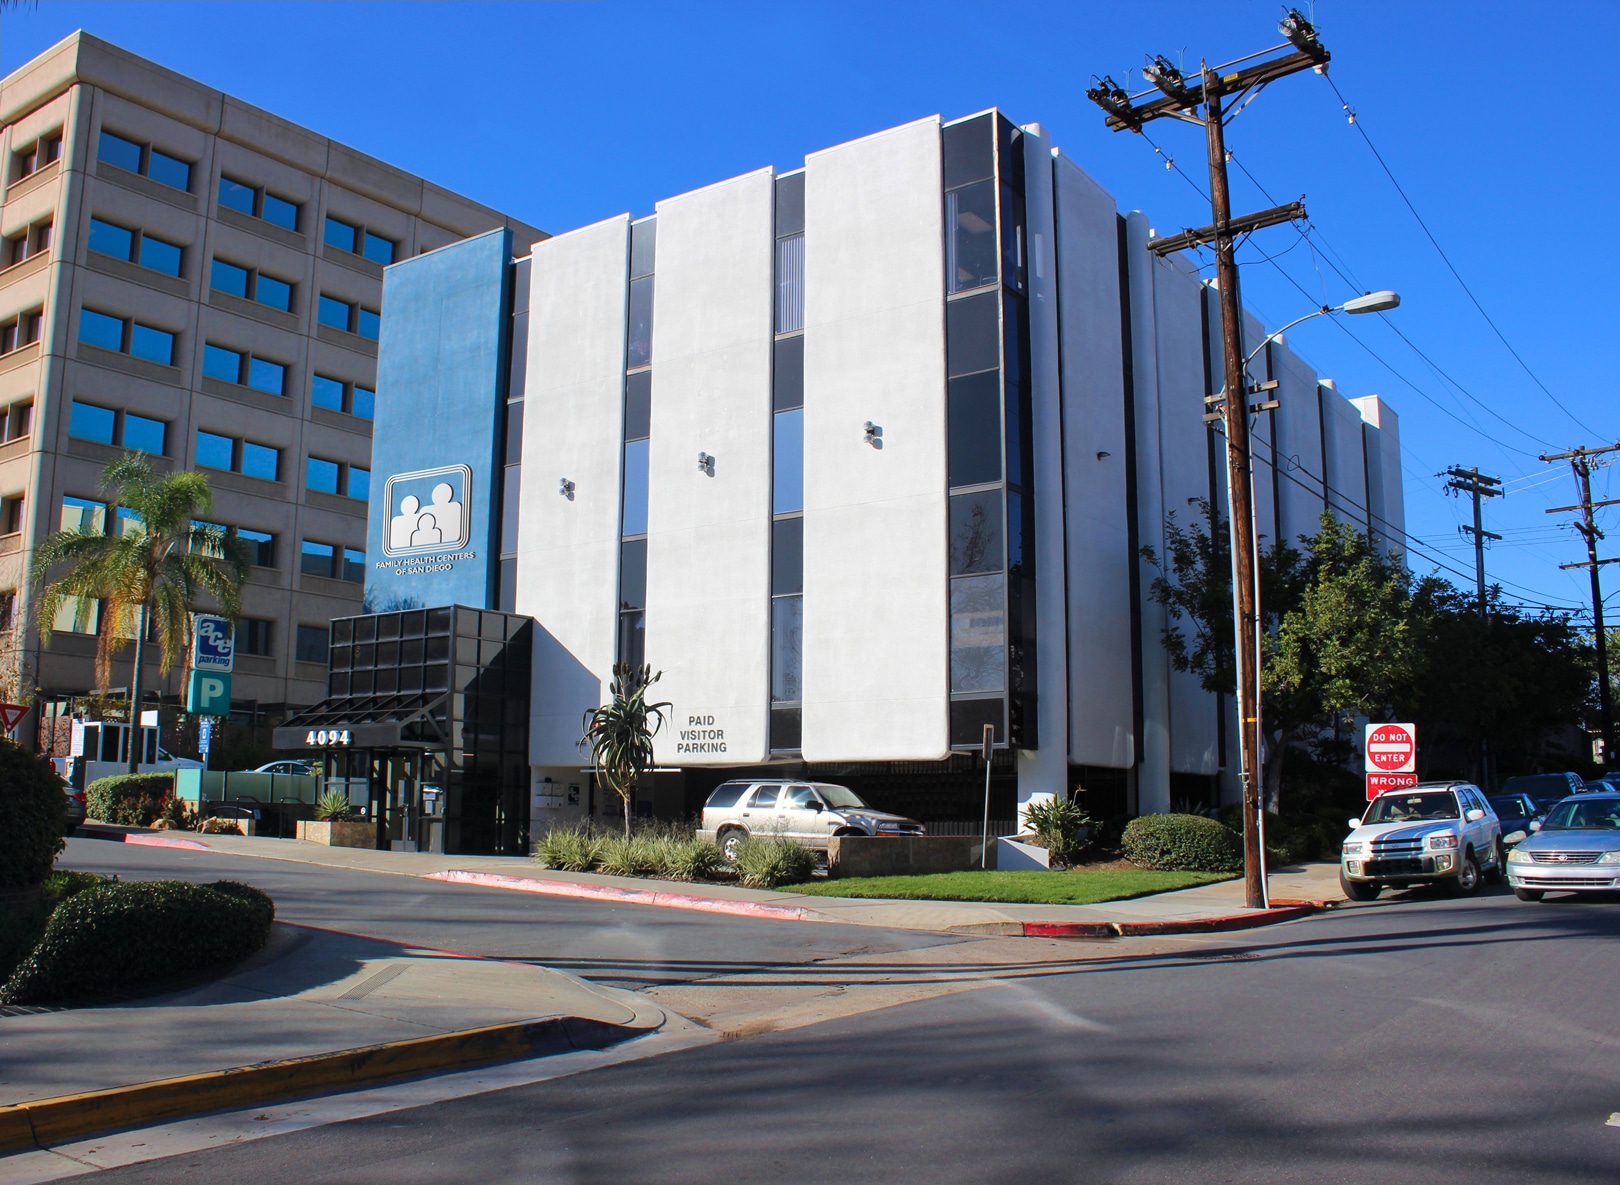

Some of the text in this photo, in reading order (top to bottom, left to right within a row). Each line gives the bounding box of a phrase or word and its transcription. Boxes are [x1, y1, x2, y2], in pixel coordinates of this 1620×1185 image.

[376, 551, 476, 569] FAMILY HEALTH CENTERS
[395, 563, 453, 576] OF SAN DIEGO
[200, 622, 231, 653] ace
[199, 655, 230, 667] parking
[201, 677, 224, 708] P
[688, 715, 715, 726] PAID
[306, 730, 351, 745] 4094
[680, 729, 724, 741] VISITOR
[1373, 733, 1407, 742] DO NOT
[677, 742, 727, 753] PARKING
[1374, 754, 1405, 762] ENTER
[1370, 777, 1414, 786] WRONG
